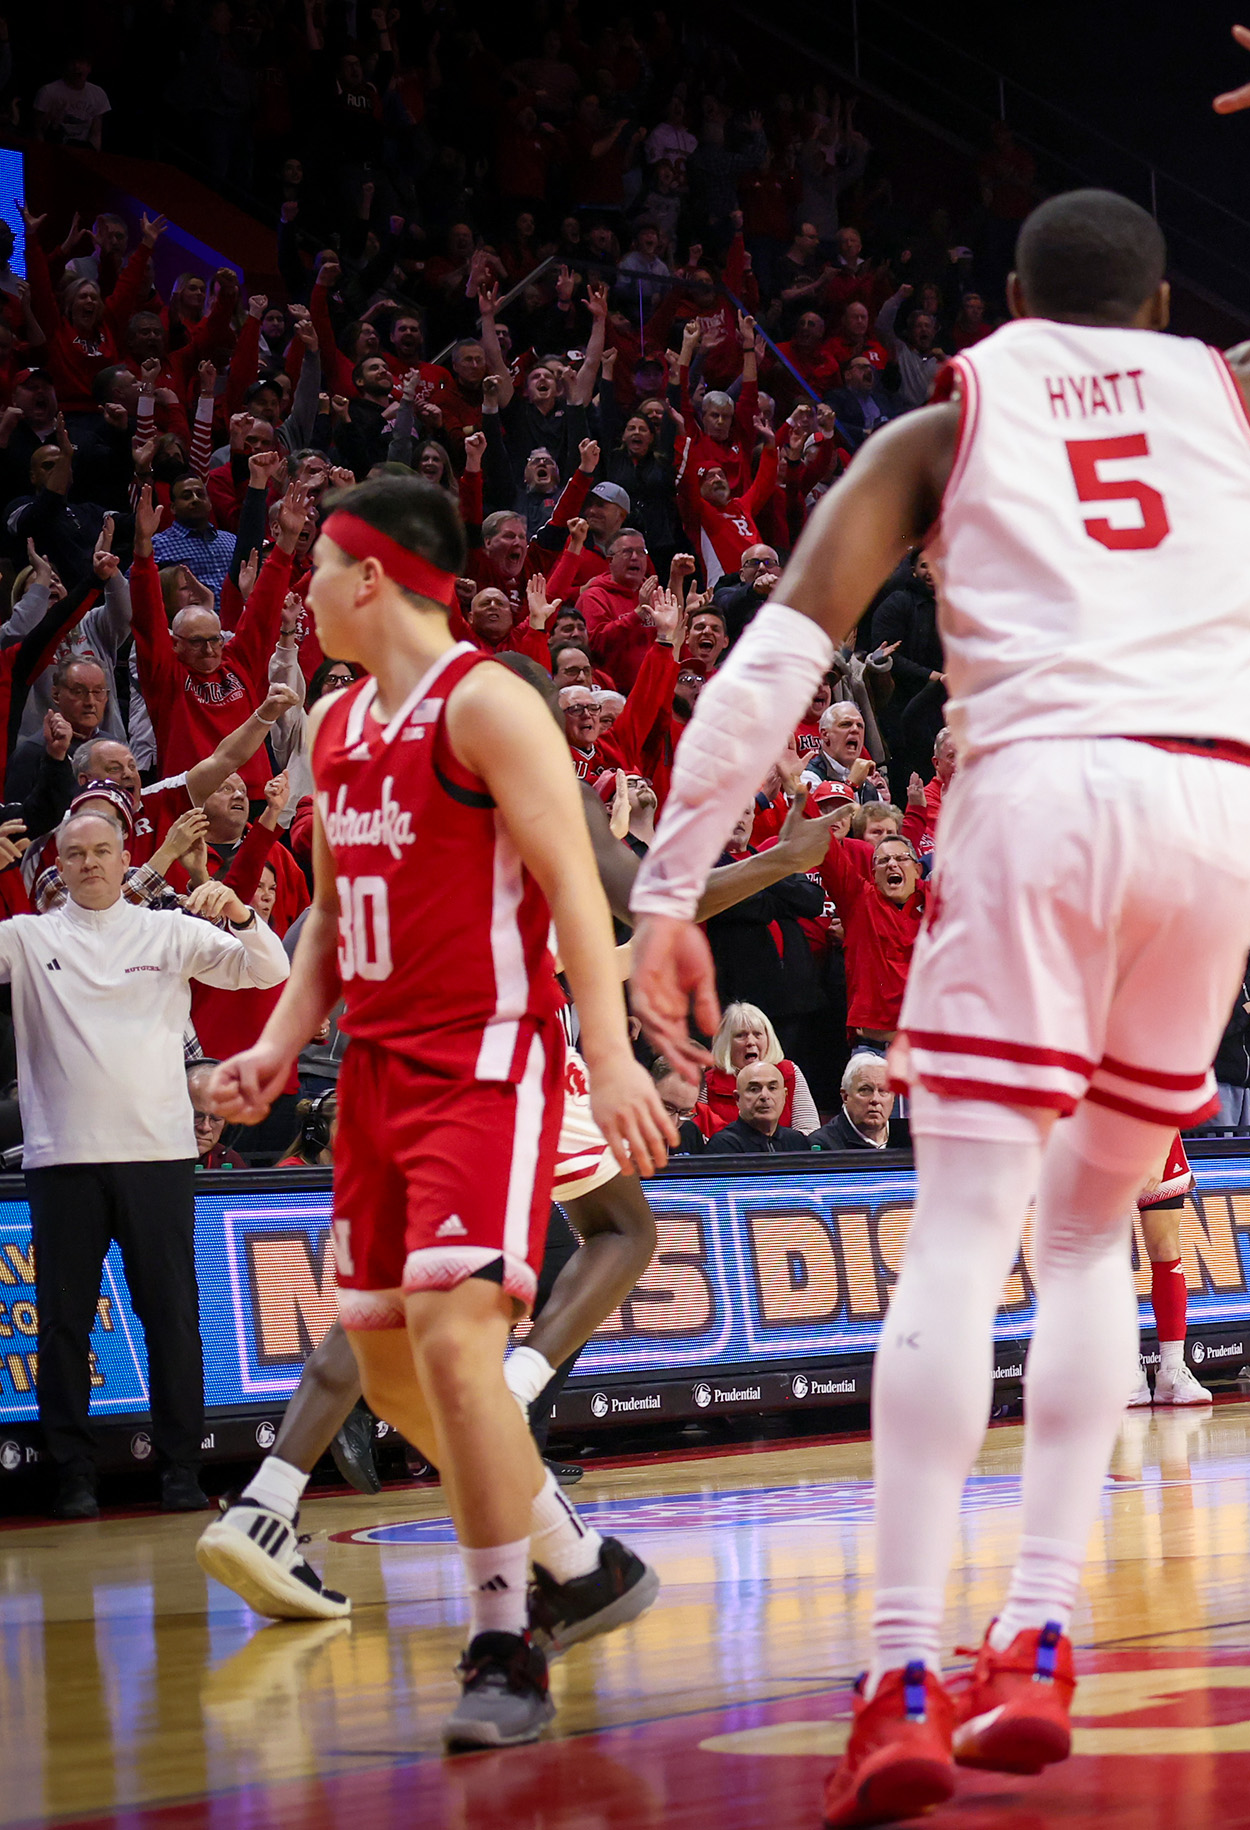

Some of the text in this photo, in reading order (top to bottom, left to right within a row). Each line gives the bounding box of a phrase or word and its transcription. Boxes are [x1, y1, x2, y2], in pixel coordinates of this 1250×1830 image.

[1045, 370, 1144, 419] HYATT
[1064, 433, 1170, 551] 5
[732, 518, 754, 536] R
[830, 783, 846, 794] R
[134, 816, 154, 837] R
[1207, 1342, 1243, 1359] Prudential
[990, 1364, 1022, 1379] udential
[714, 1386, 761, 1403] Prudential
[810, 1379, 856, 1395] Prudential
[611, 1395, 661, 1413] Prudential
